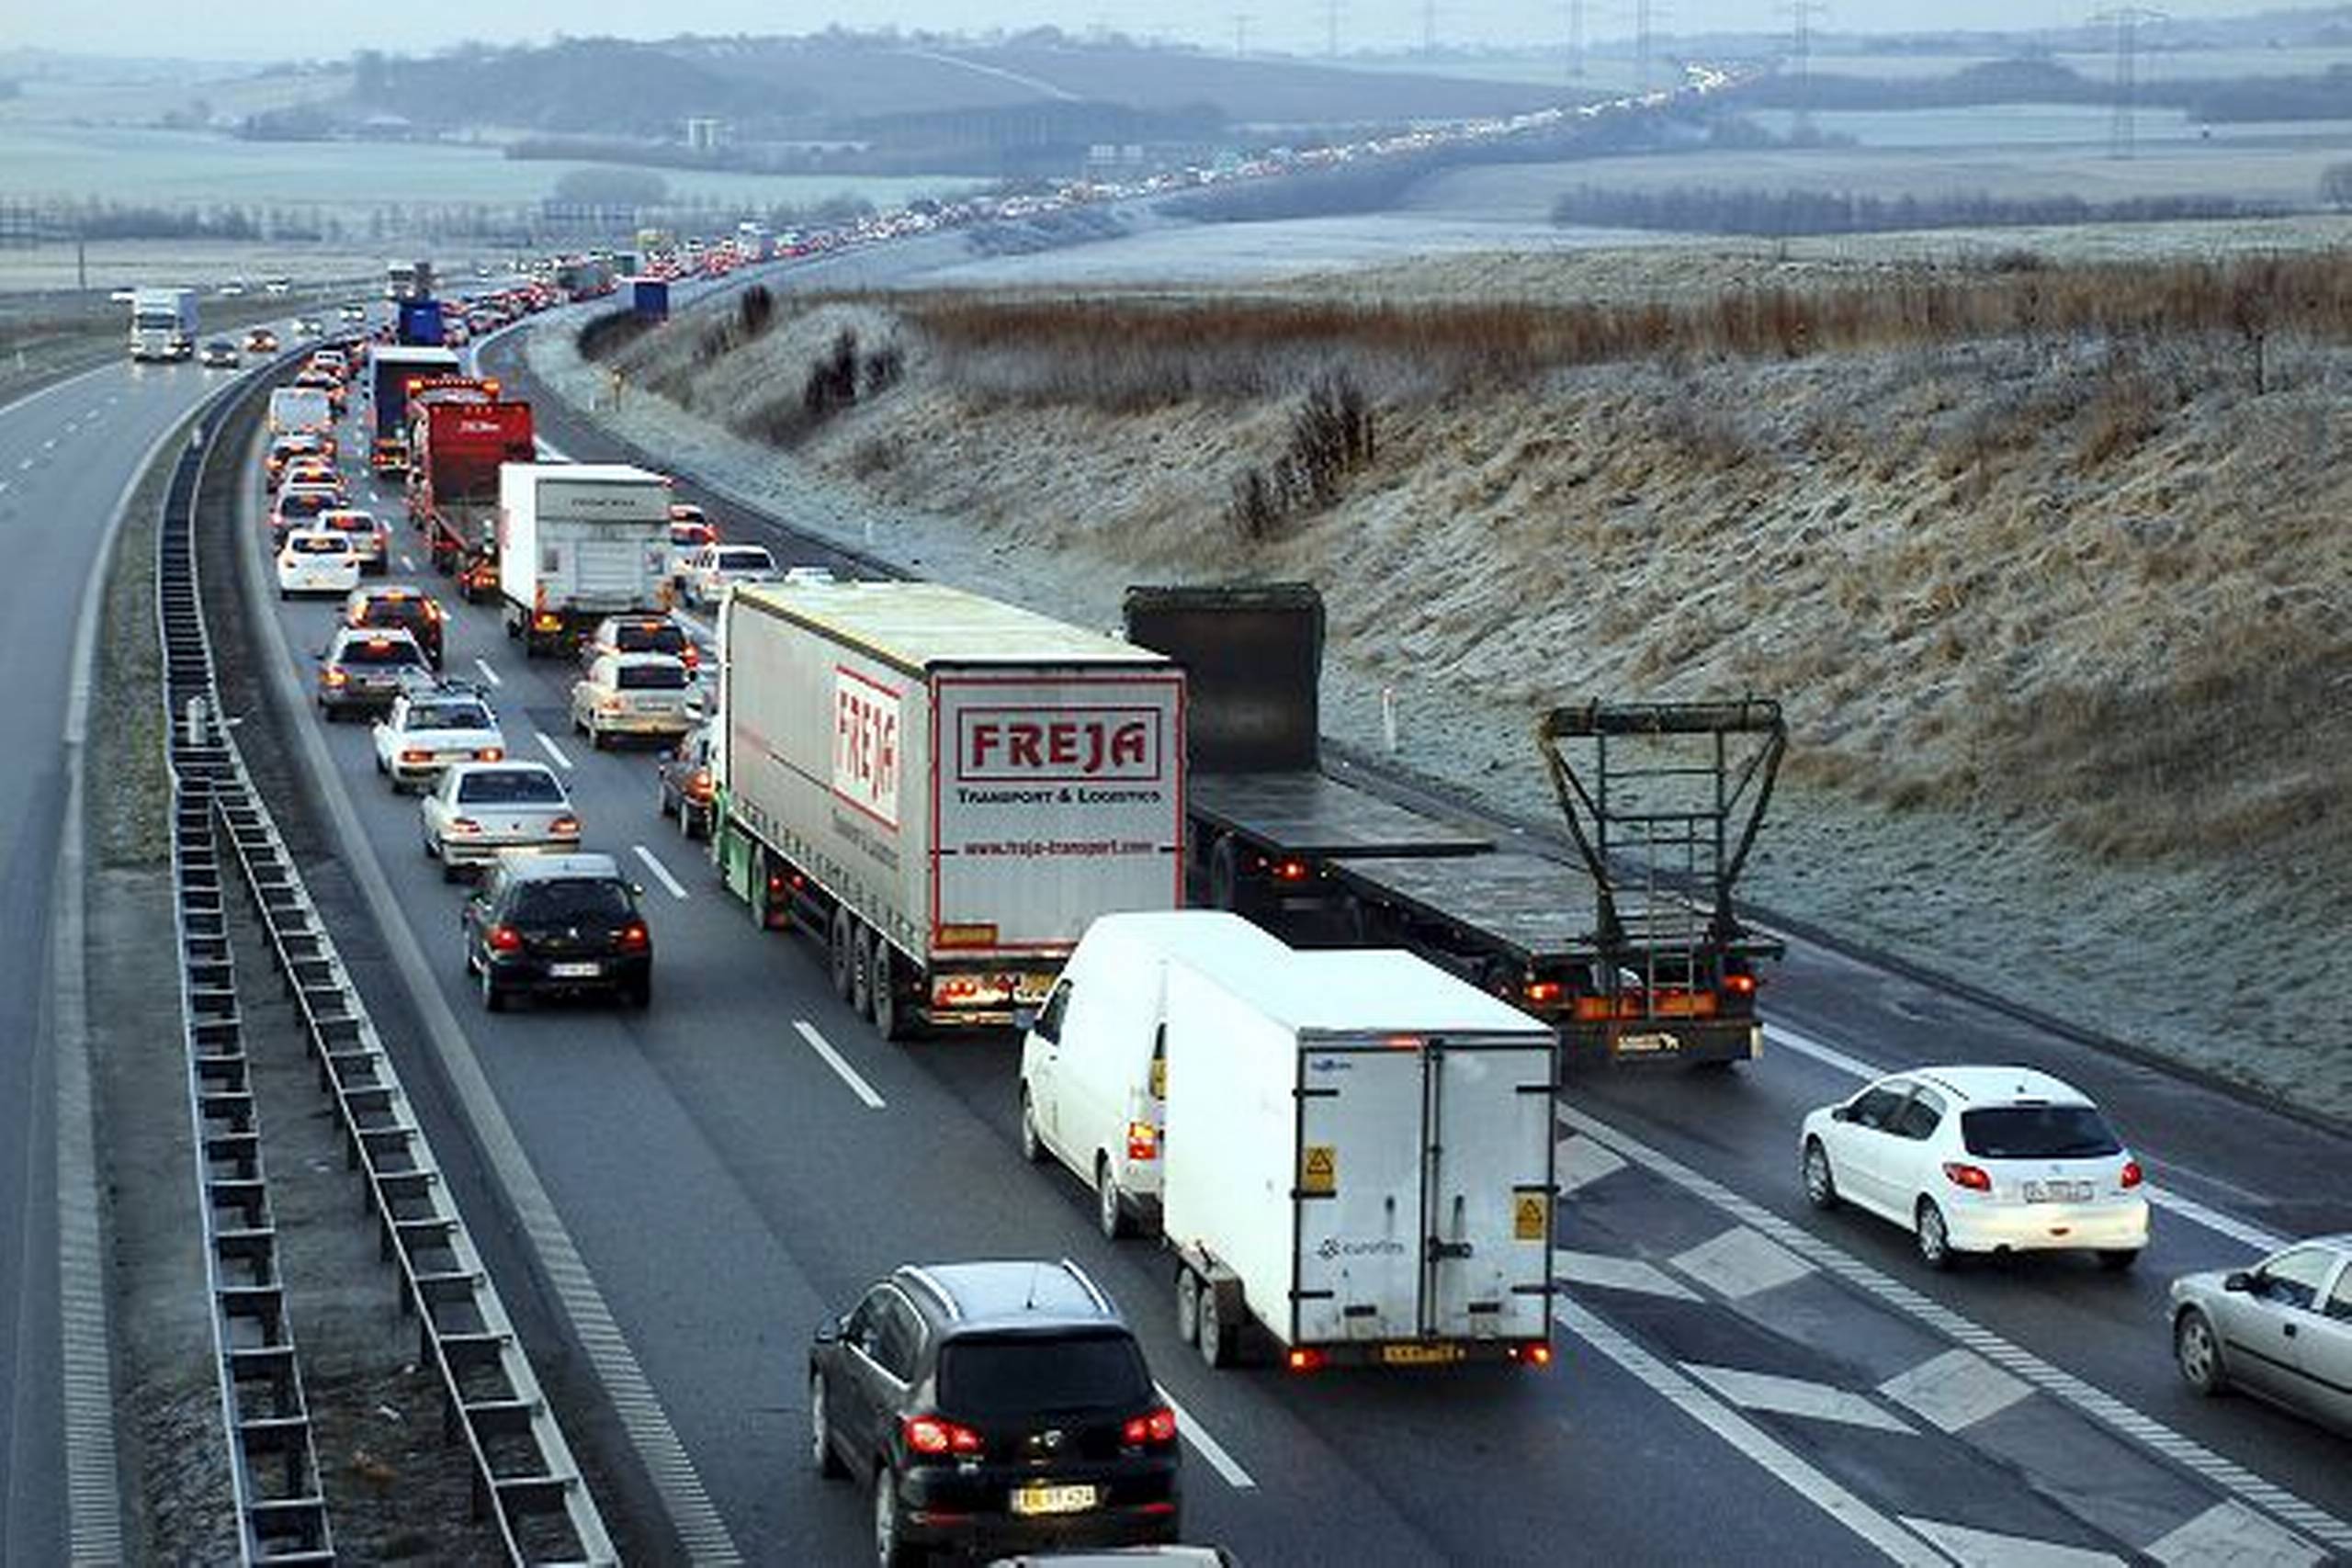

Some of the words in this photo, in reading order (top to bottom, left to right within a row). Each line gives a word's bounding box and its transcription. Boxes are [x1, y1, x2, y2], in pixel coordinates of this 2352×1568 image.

[839, 691, 896, 800] FREJA
[972, 722, 1147, 773] FREJA
[1057, 788, 1071, 804] &
